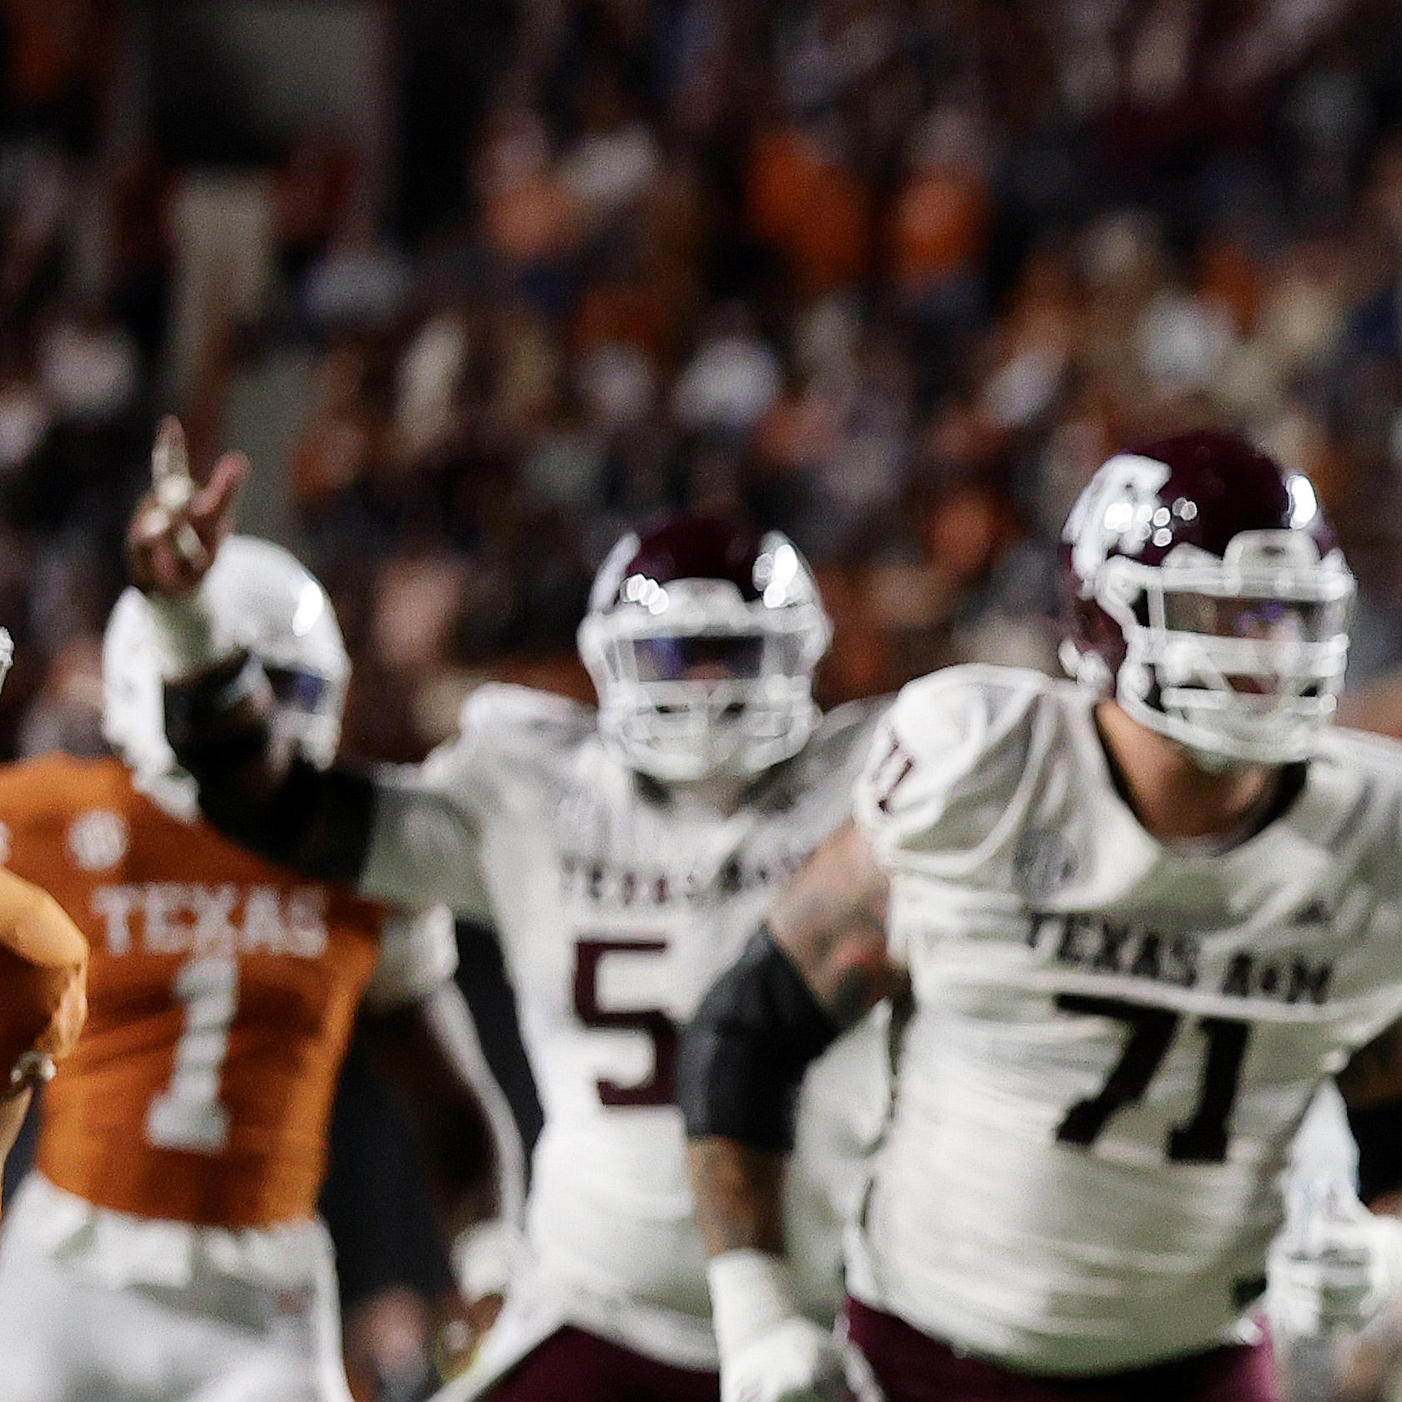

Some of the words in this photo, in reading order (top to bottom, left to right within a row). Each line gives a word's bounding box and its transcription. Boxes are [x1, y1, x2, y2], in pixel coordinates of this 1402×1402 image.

[92, 883, 328, 957] TEXAS
[1026, 912, 1197, 988] TEXAS
[146, 954, 239, 1154] 1
[573, 939, 681, 1106] 5
[1056, 992, 1249, 1163] 71
